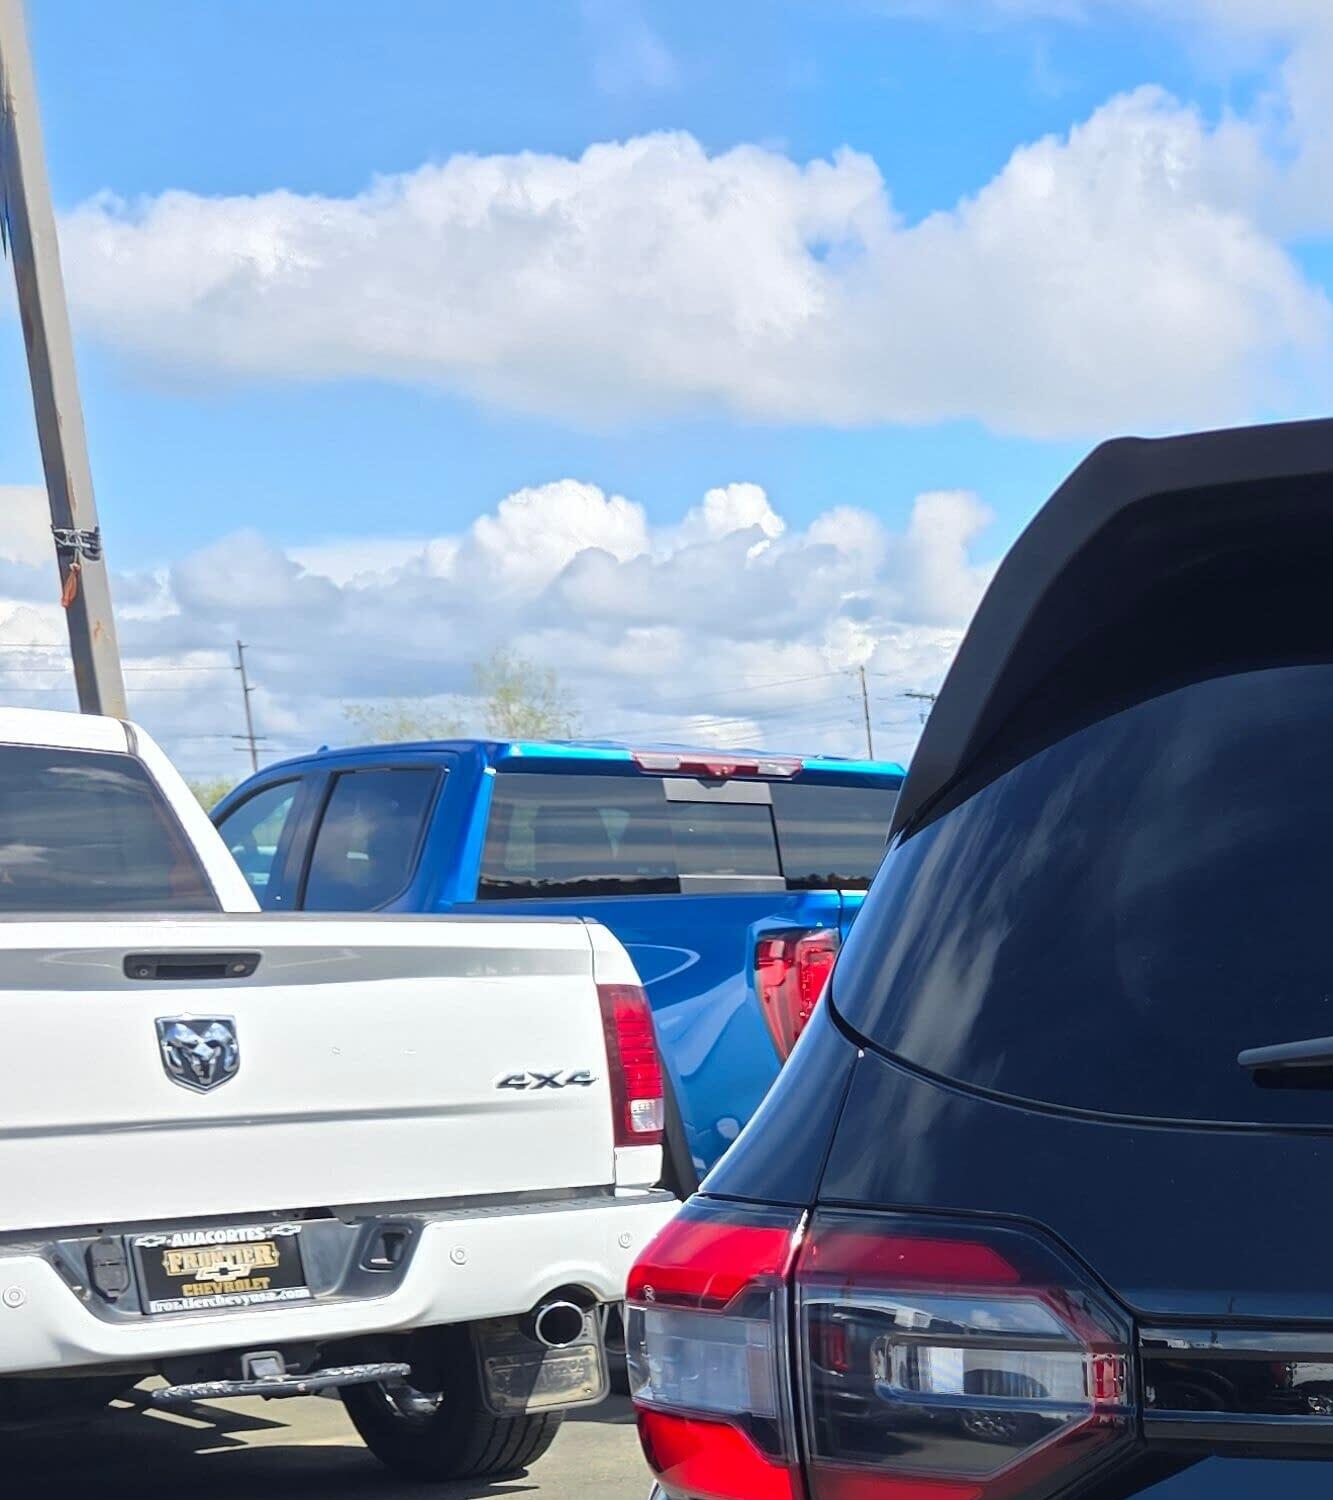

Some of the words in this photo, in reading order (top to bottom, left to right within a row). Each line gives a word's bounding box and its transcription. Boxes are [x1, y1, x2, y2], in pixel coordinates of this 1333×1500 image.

[170, 1227, 267, 1247] ANACORTES
[167, 1244, 275, 1274] FRONTIER
[181, 1277, 271, 1297] CHEVROLET
